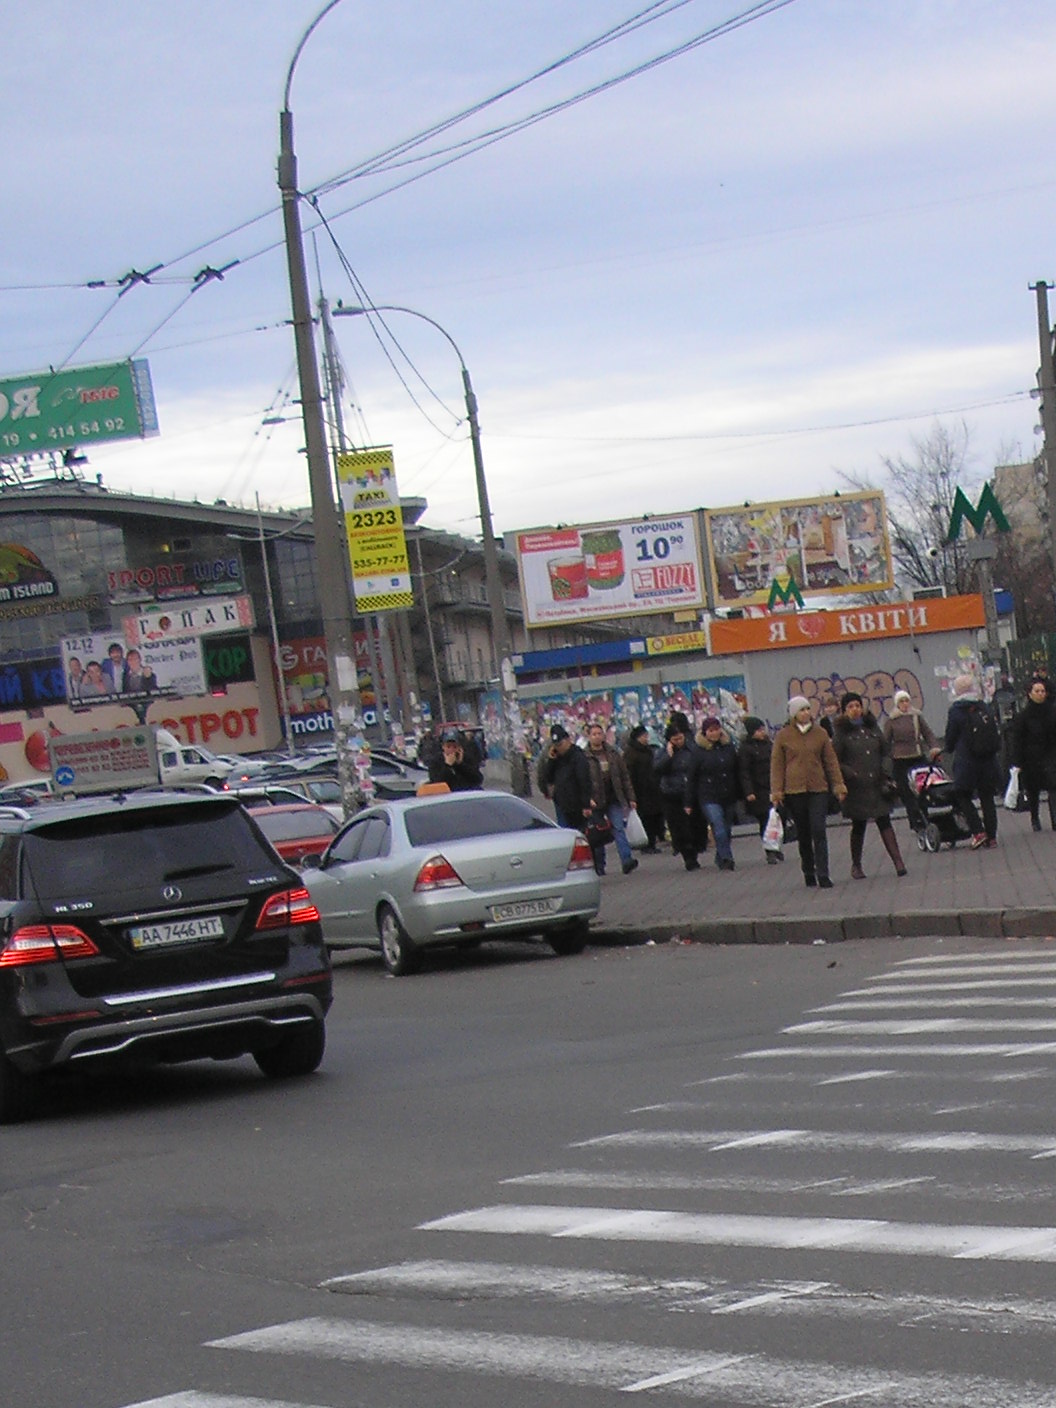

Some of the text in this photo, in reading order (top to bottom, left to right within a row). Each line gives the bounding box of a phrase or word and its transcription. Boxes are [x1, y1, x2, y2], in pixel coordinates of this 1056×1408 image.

[352, 509, 397, 529] 2323
[631, 520, 685, 535] ГОРОШОК
[656, 563, 696, 589] FOZZY
[839, 606, 928, 635] КВІТИ
[141, 918, 218, 944] AA 7446 HT
